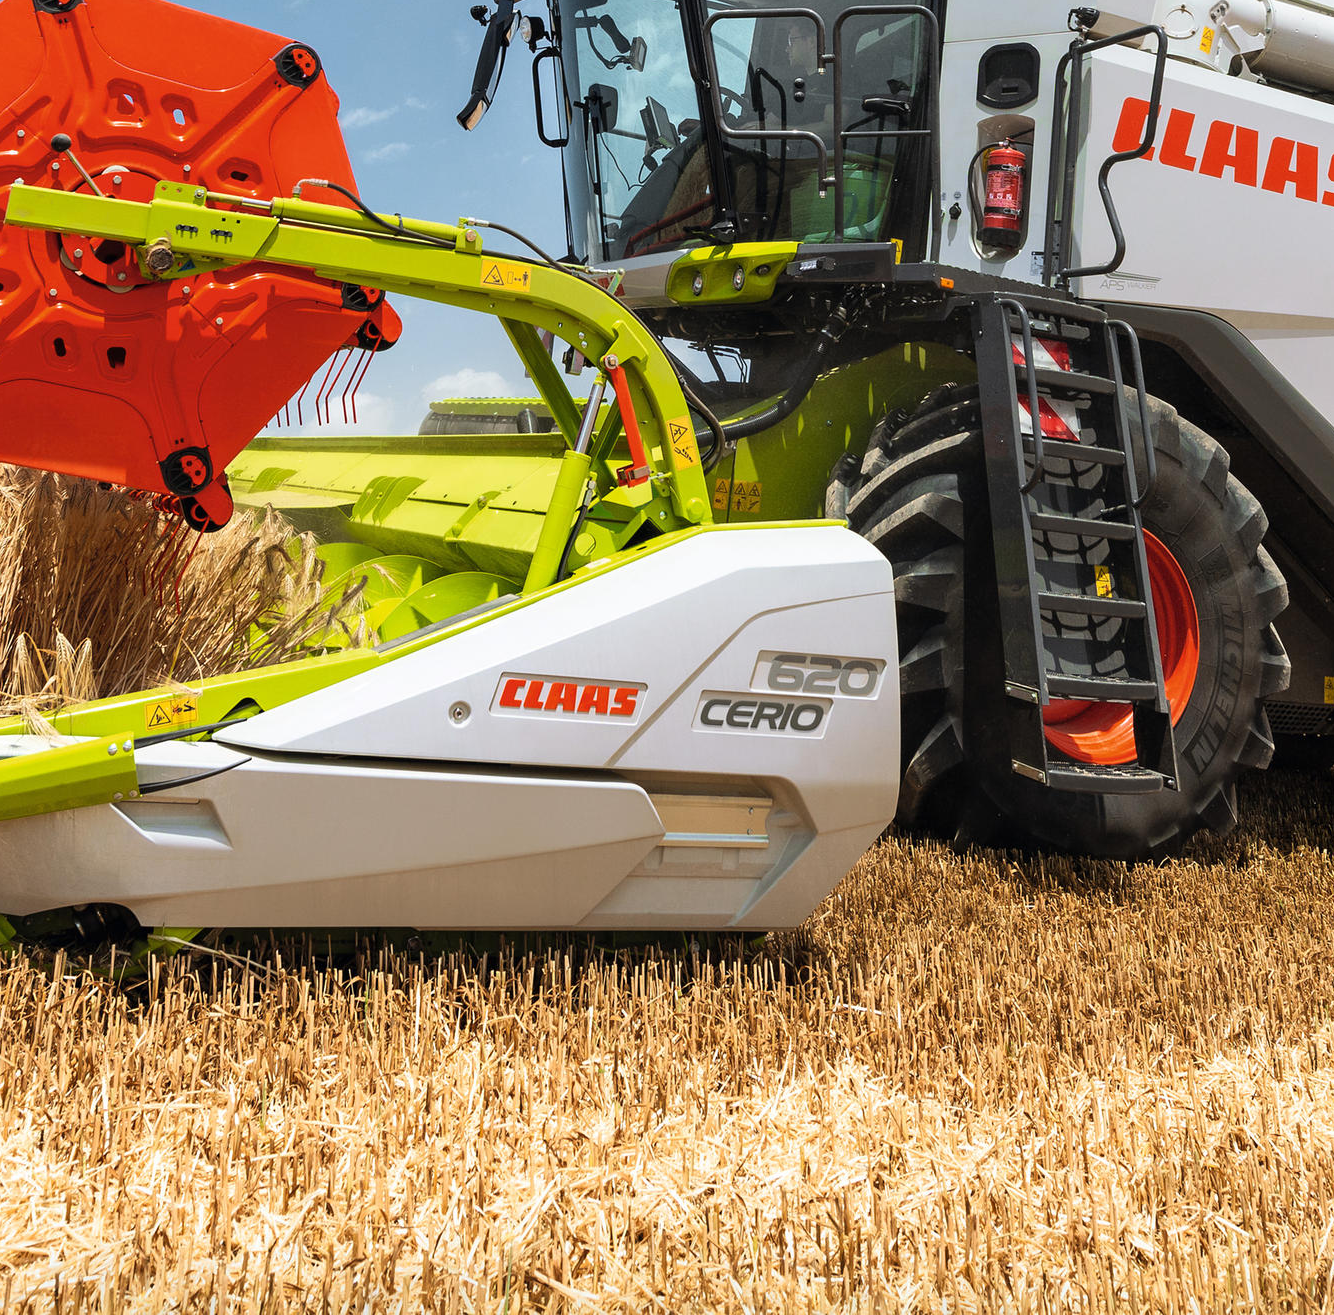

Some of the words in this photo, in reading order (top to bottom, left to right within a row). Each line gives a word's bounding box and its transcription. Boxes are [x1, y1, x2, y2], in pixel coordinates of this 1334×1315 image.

[1099, 279, 1126, 291] APS
[767, 654, 878, 696] 620
[1188, 600, 1244, 773] MICHELIN
[499, 679, 638, 716] CLAAS
[700, 699, 825, 731] CERIO
